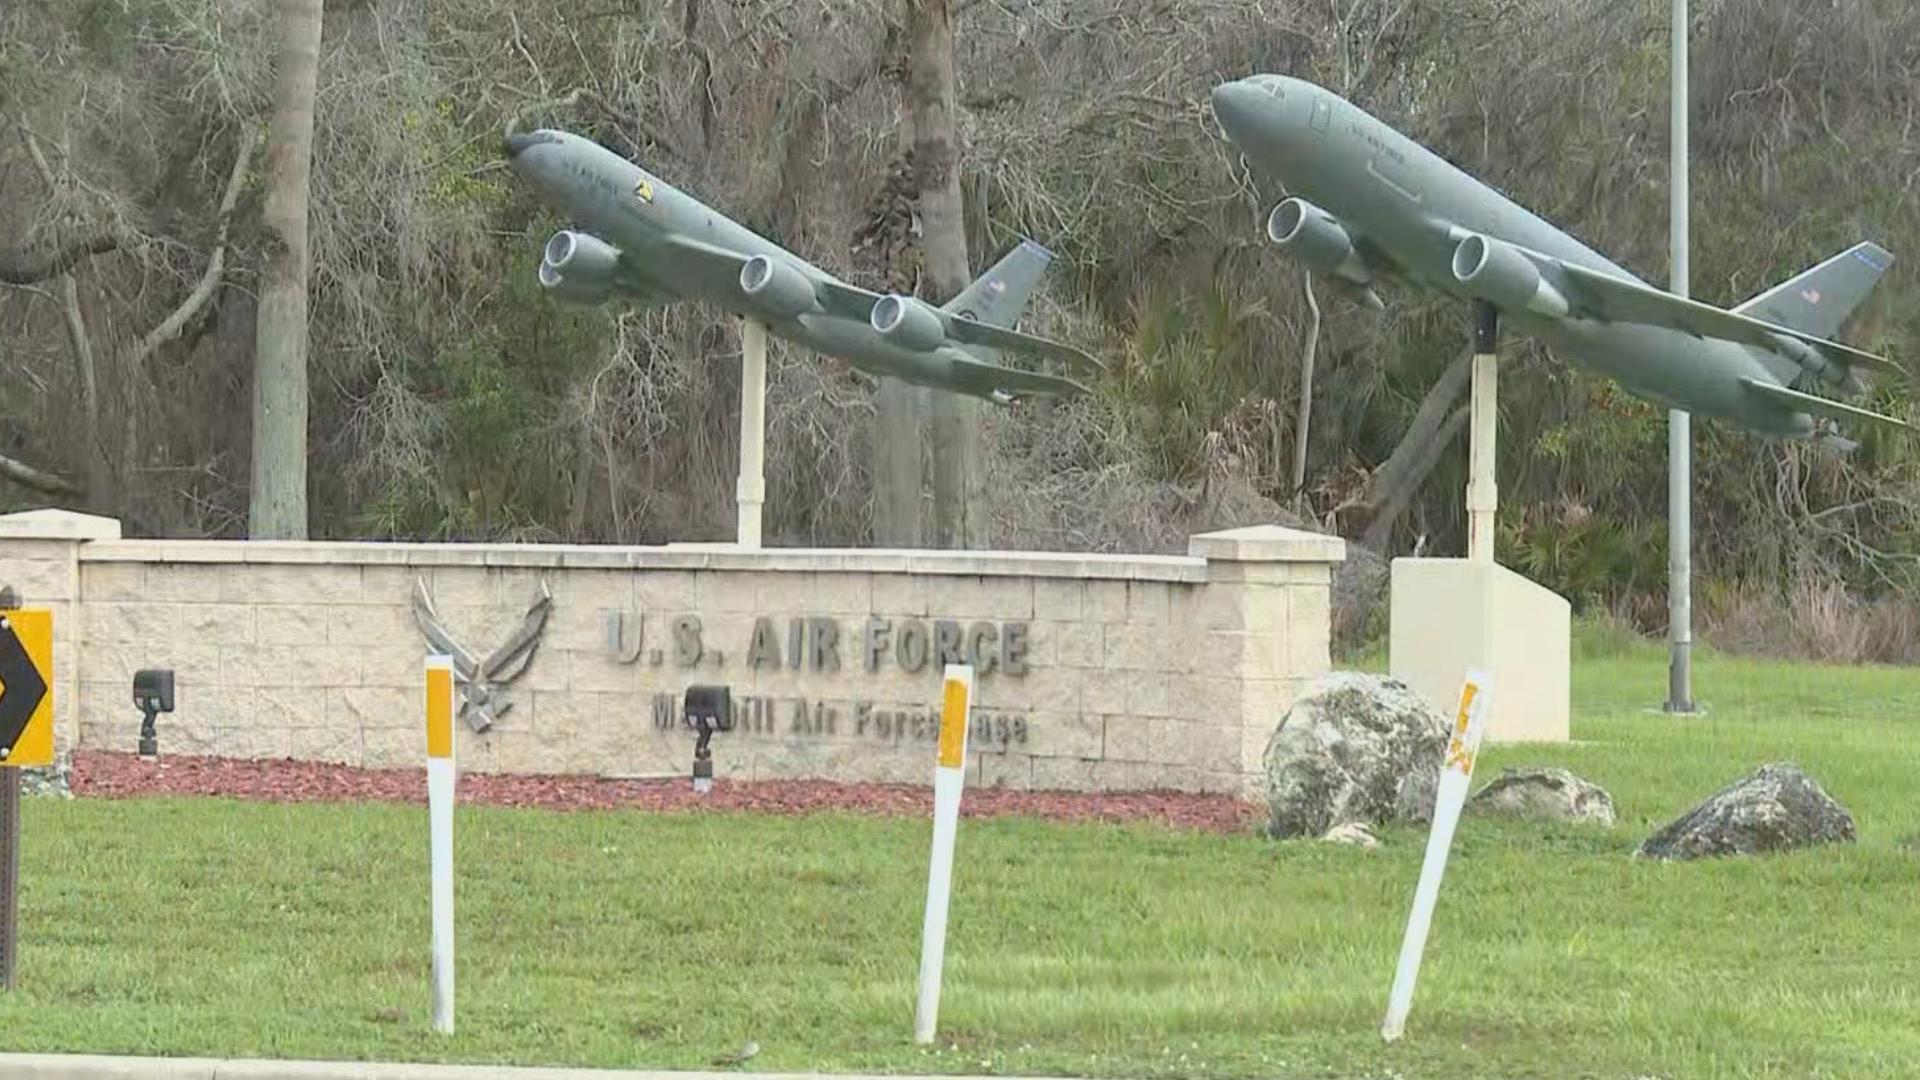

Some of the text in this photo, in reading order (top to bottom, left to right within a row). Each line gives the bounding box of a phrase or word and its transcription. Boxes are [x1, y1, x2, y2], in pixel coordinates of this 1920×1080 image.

[607, 611, 1029, 677] U.S. AIR FORCE
[652, 693, 774, 730] Mill
[791, 696, 837, 735] Air
[968, 711, 1028, 744] ase
